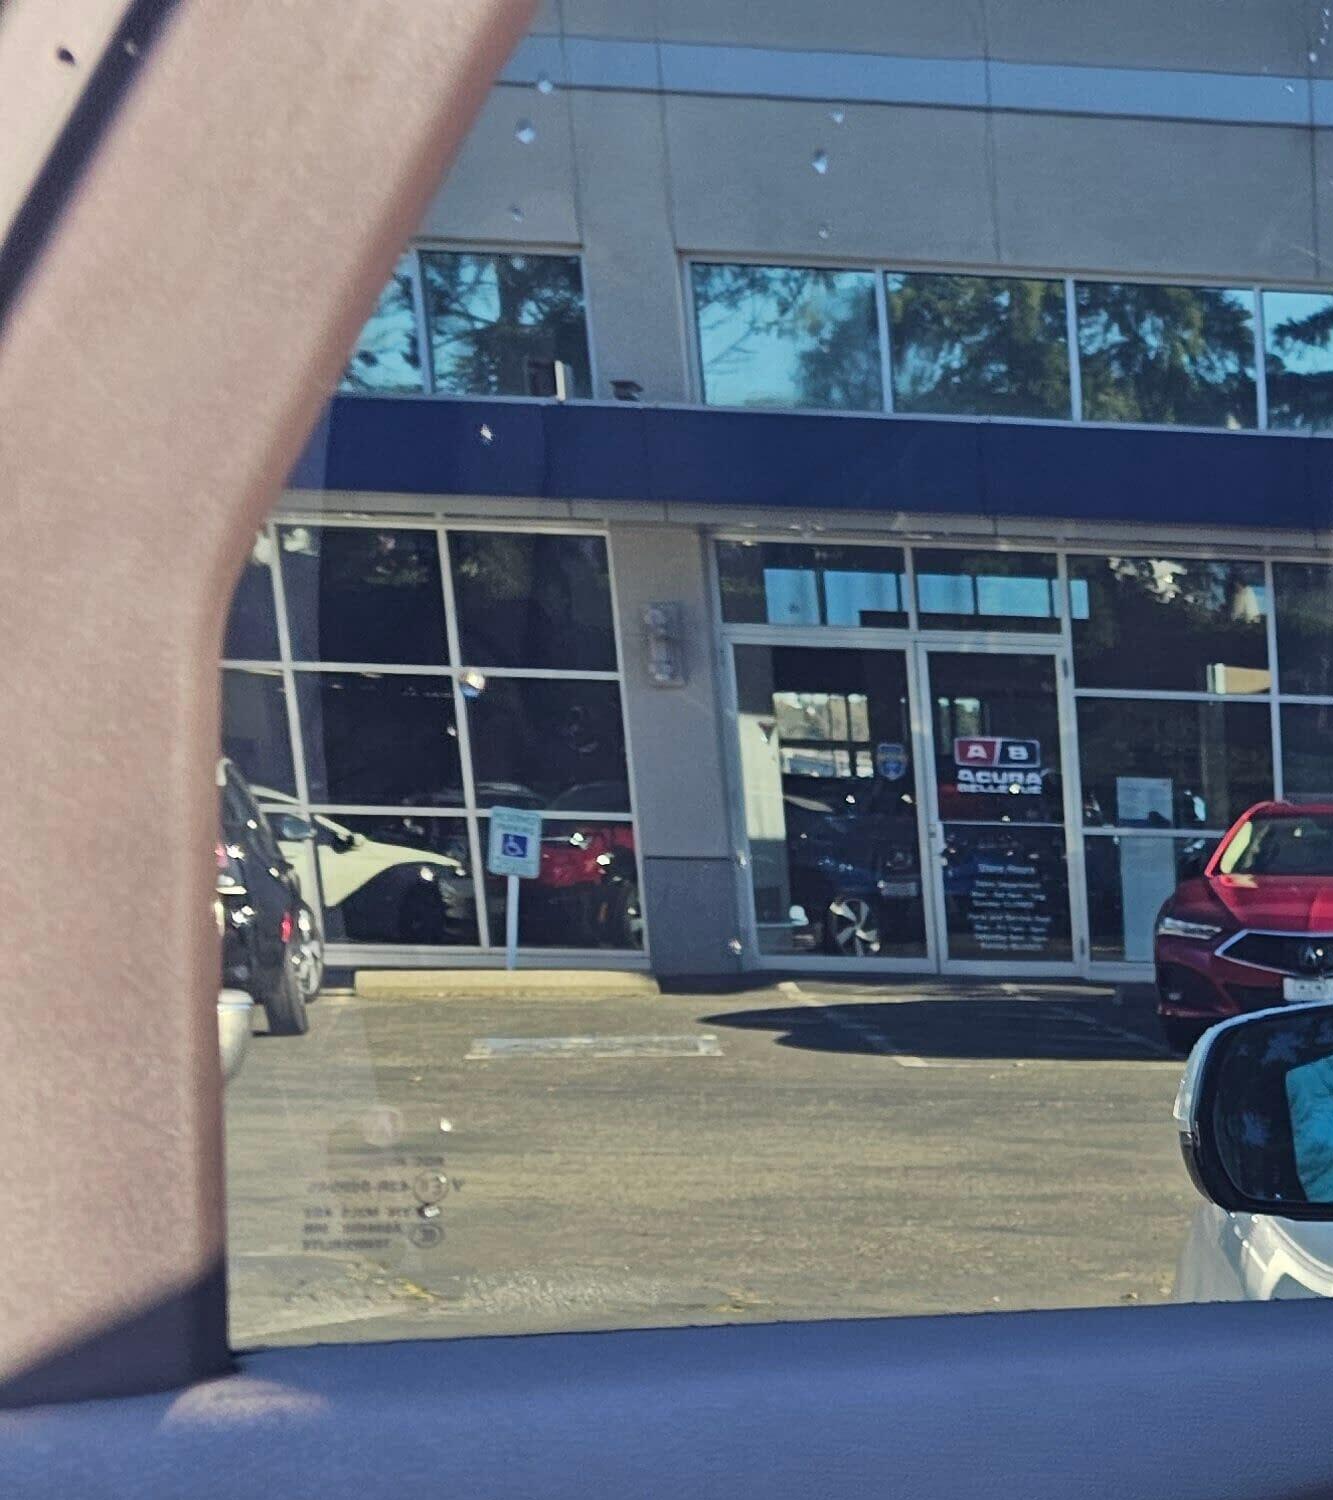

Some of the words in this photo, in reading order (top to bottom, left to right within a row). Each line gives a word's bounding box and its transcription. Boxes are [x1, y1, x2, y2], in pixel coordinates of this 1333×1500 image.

[967, 744, 987, 759] A
[1007, 745, 1028, 760] B
[957, 769, 1042, 785] ACURA
[956, 783, 1042, 795] BELLEUE
